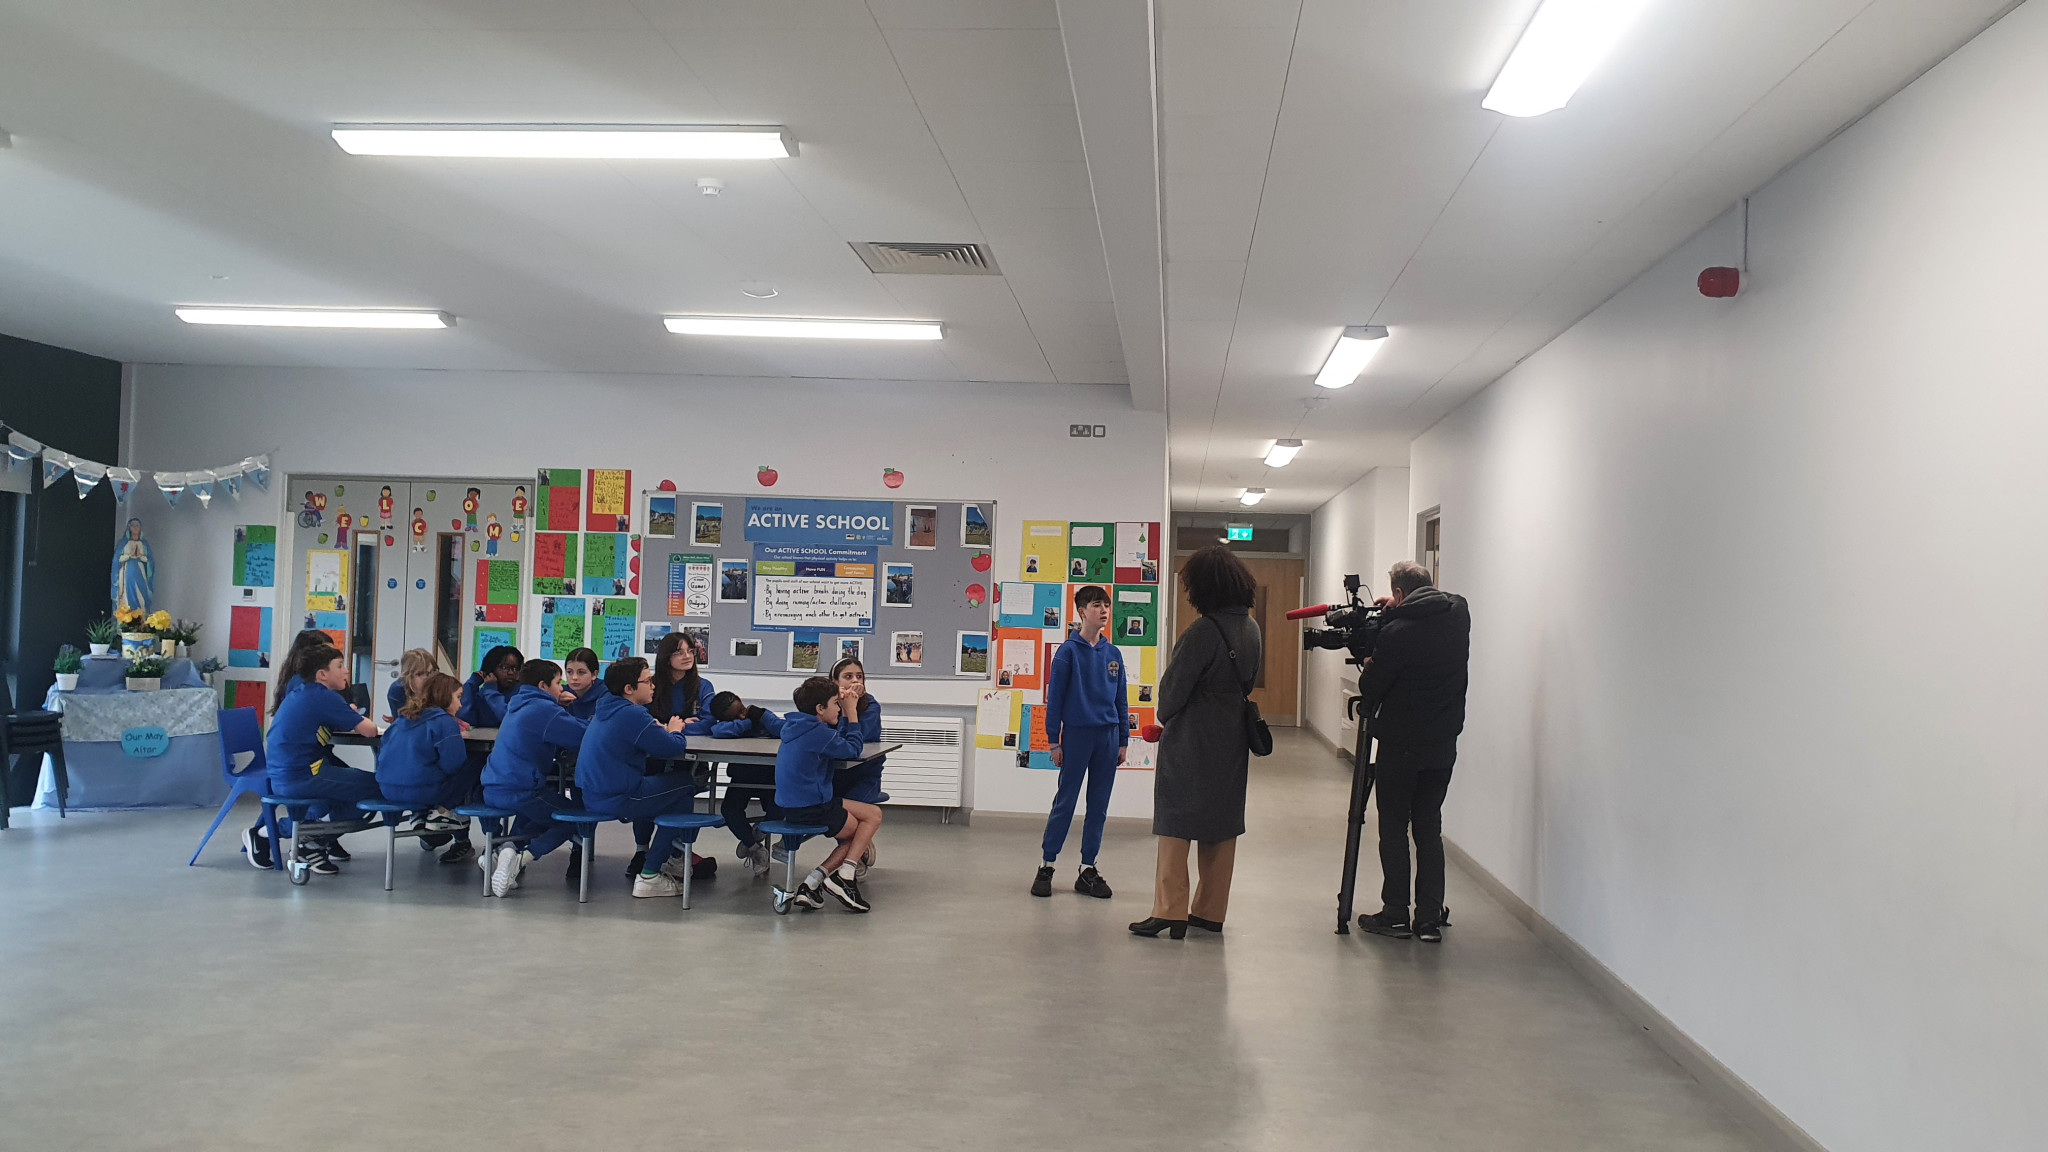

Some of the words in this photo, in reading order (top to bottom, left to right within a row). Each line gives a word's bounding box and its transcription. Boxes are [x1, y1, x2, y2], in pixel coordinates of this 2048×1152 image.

[748, 513, 809, 529] ACTIVE
[815, 514, 890, 530] SCHOOL
[776, 584, 790, 597] having
[793, 586, 809, 595] active
[814, 585, 829, 594] breaks
[832, 586, 846, 598] during
[856, 586, 867, 598] day
[775, 597, 789, 609] doing
[829, 596, 857, 608] challenges
[125, 733, 142, 741] Our
[145, 733, 163, 741] May
